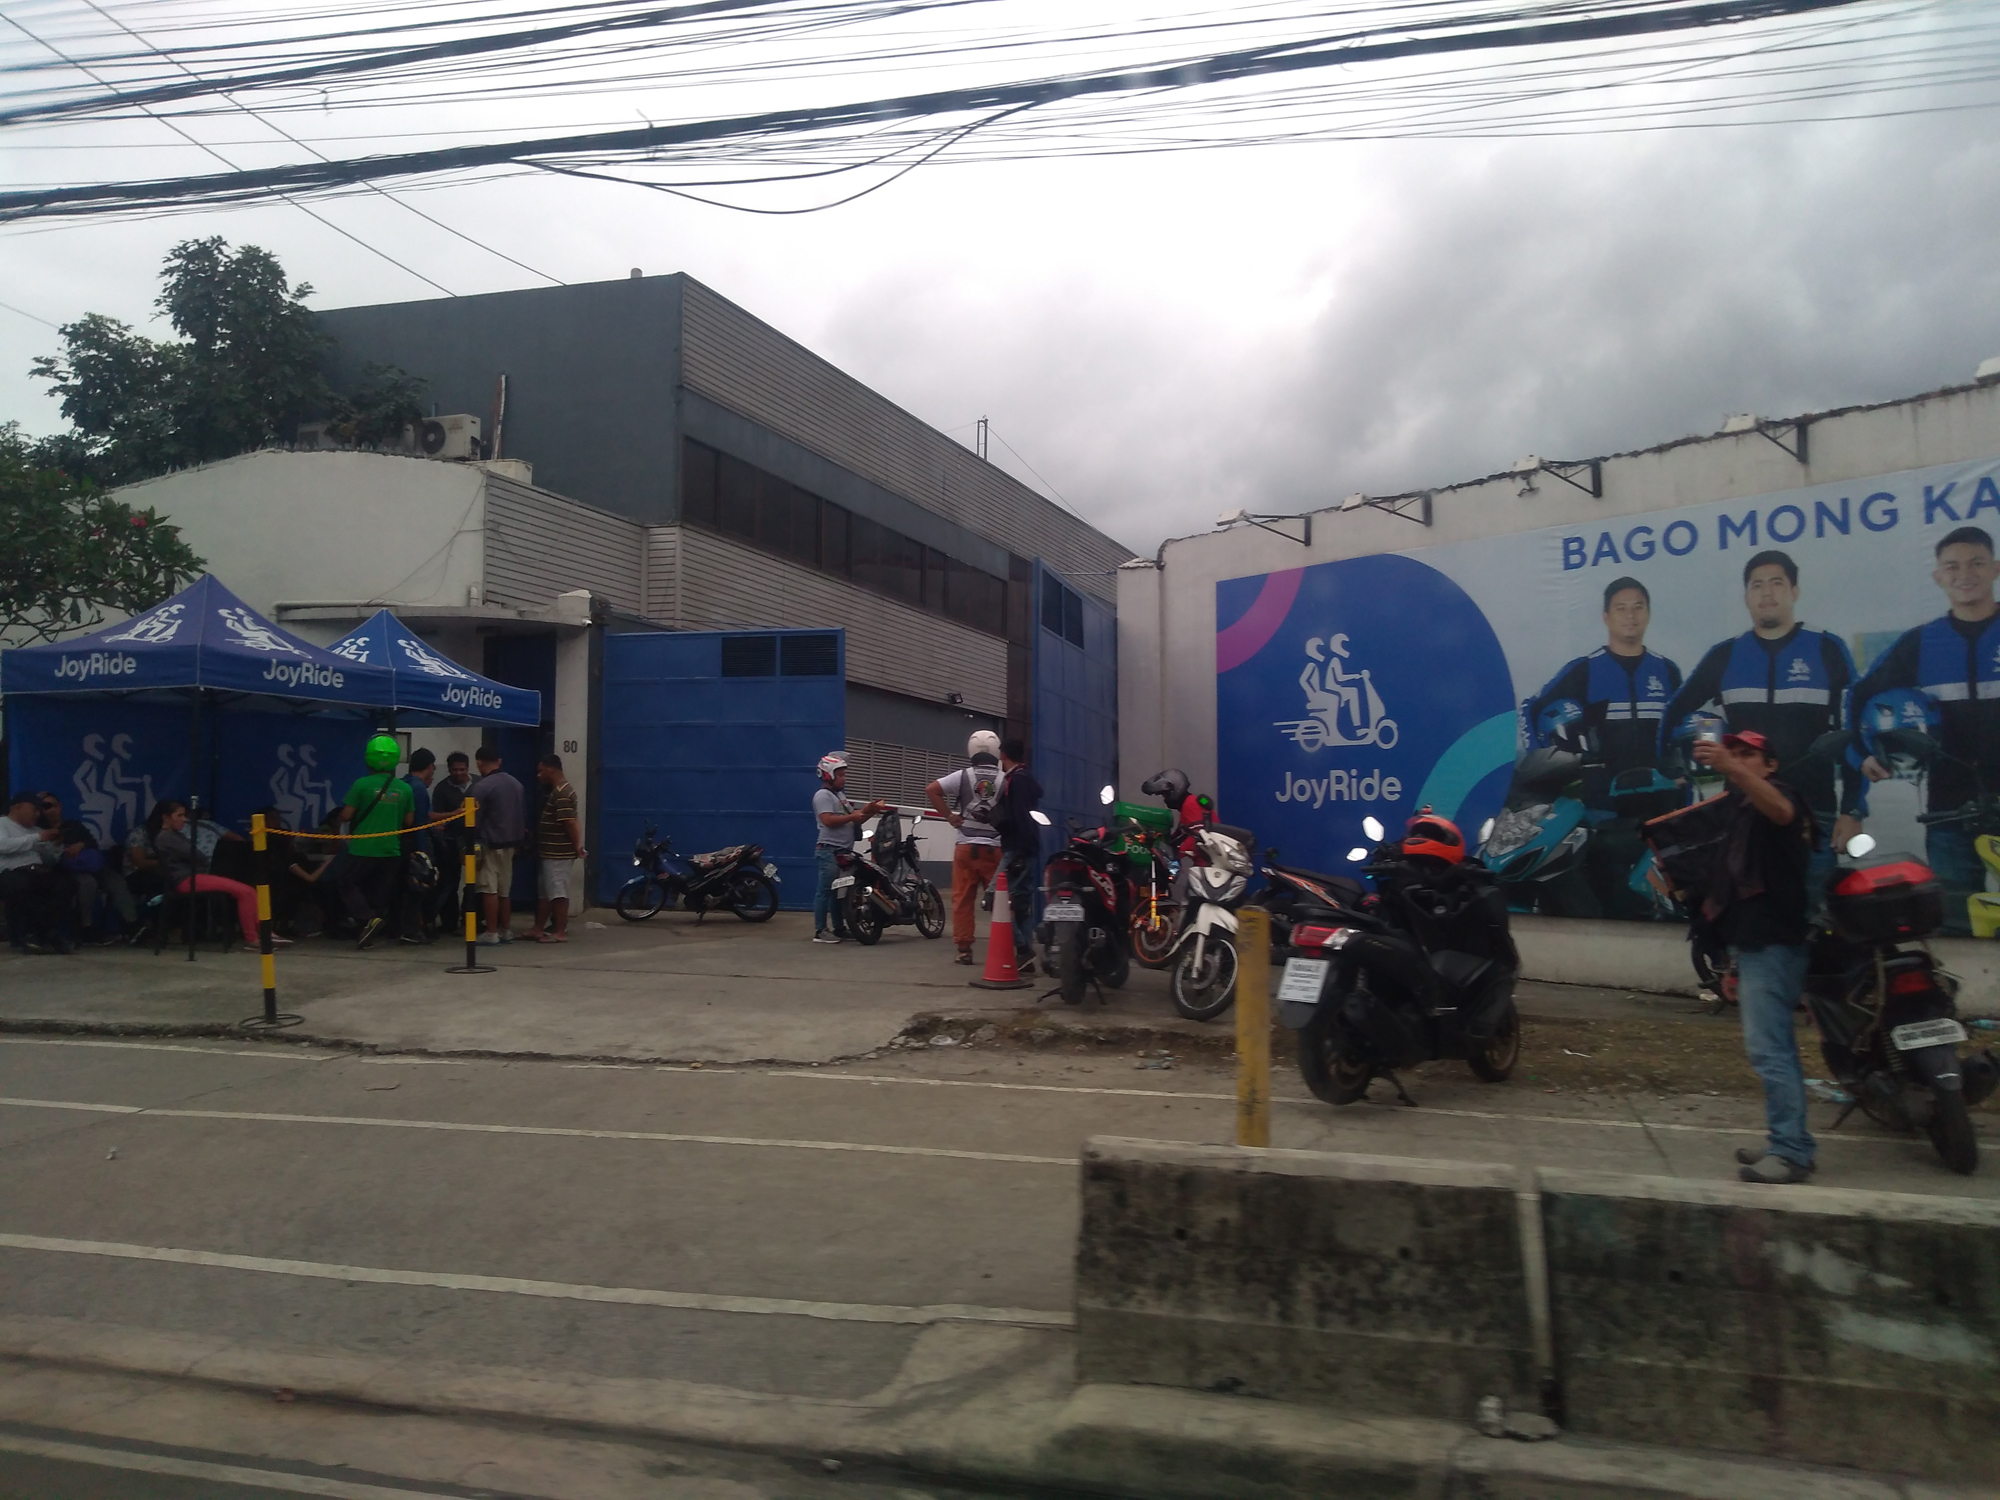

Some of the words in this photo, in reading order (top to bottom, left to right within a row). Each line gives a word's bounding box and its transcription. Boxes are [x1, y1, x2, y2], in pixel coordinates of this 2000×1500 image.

[1562, 519, 1699, 571] BAGO
[1718, 491, 1899, 551] MONG
[1923, 476, 2000, 525] KA
[54, 651, 137, 682] JoyRide
[262, 658, 344, 689] JoyRide
[441, 682, 503, 709] JoyRide
[563, 740, 578, 753] 80
[1275, 768, 1402, 809] JoyRide
